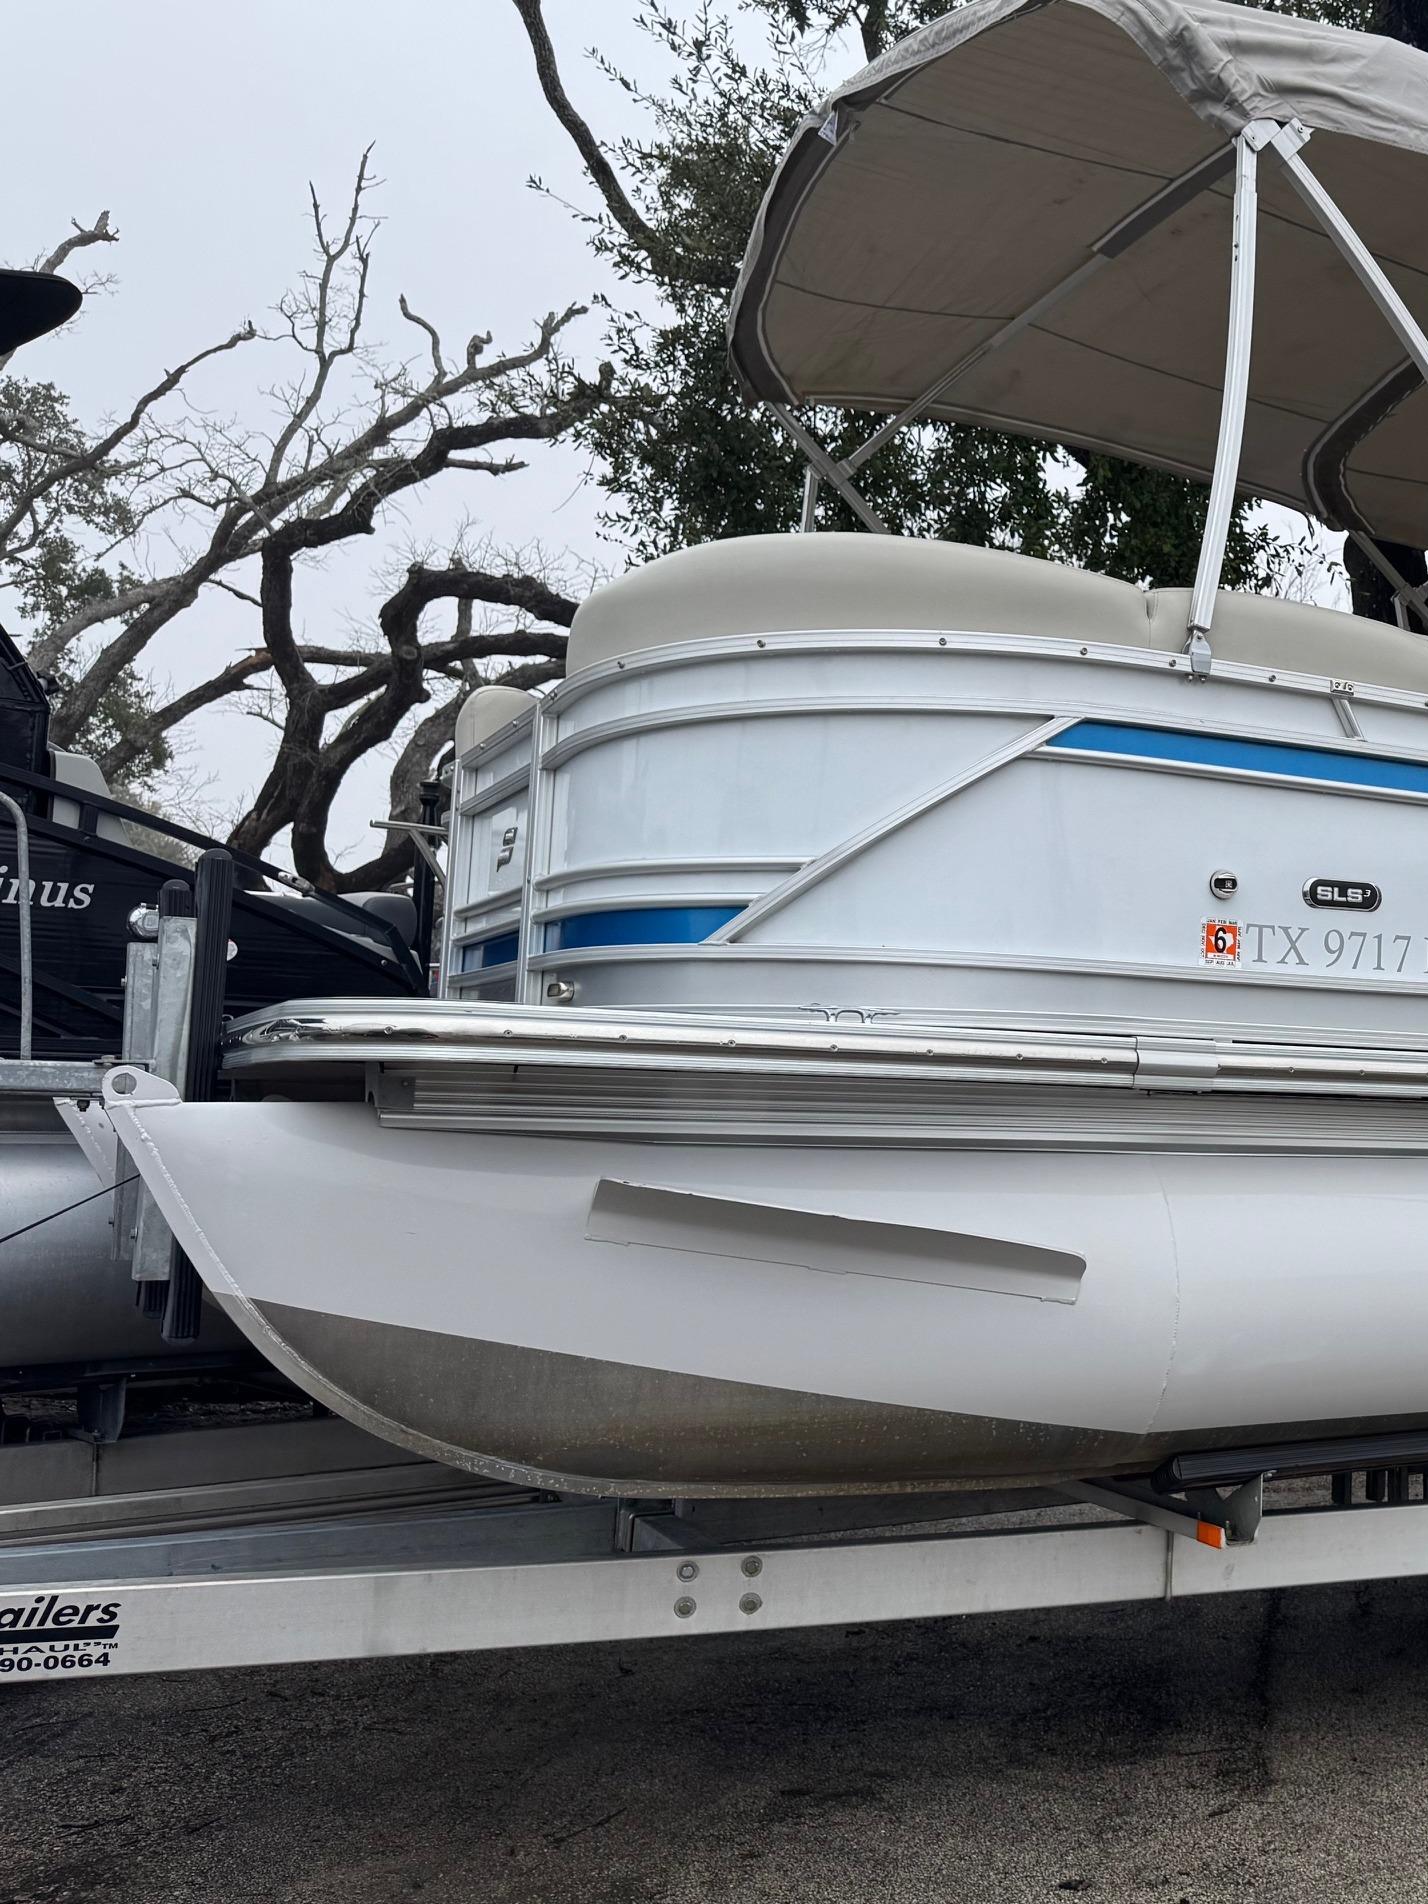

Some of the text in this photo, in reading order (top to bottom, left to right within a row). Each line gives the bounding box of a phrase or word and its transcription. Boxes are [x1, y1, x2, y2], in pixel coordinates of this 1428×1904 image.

[1214, 926, 1227, 954] 6
[1245, 923, 1310, 966] TX
[1323, 929, 1412, 973] 9717
[0, 1595, 122, 1629] ailers
[0, 1652, 111, 1673] 90-0664
